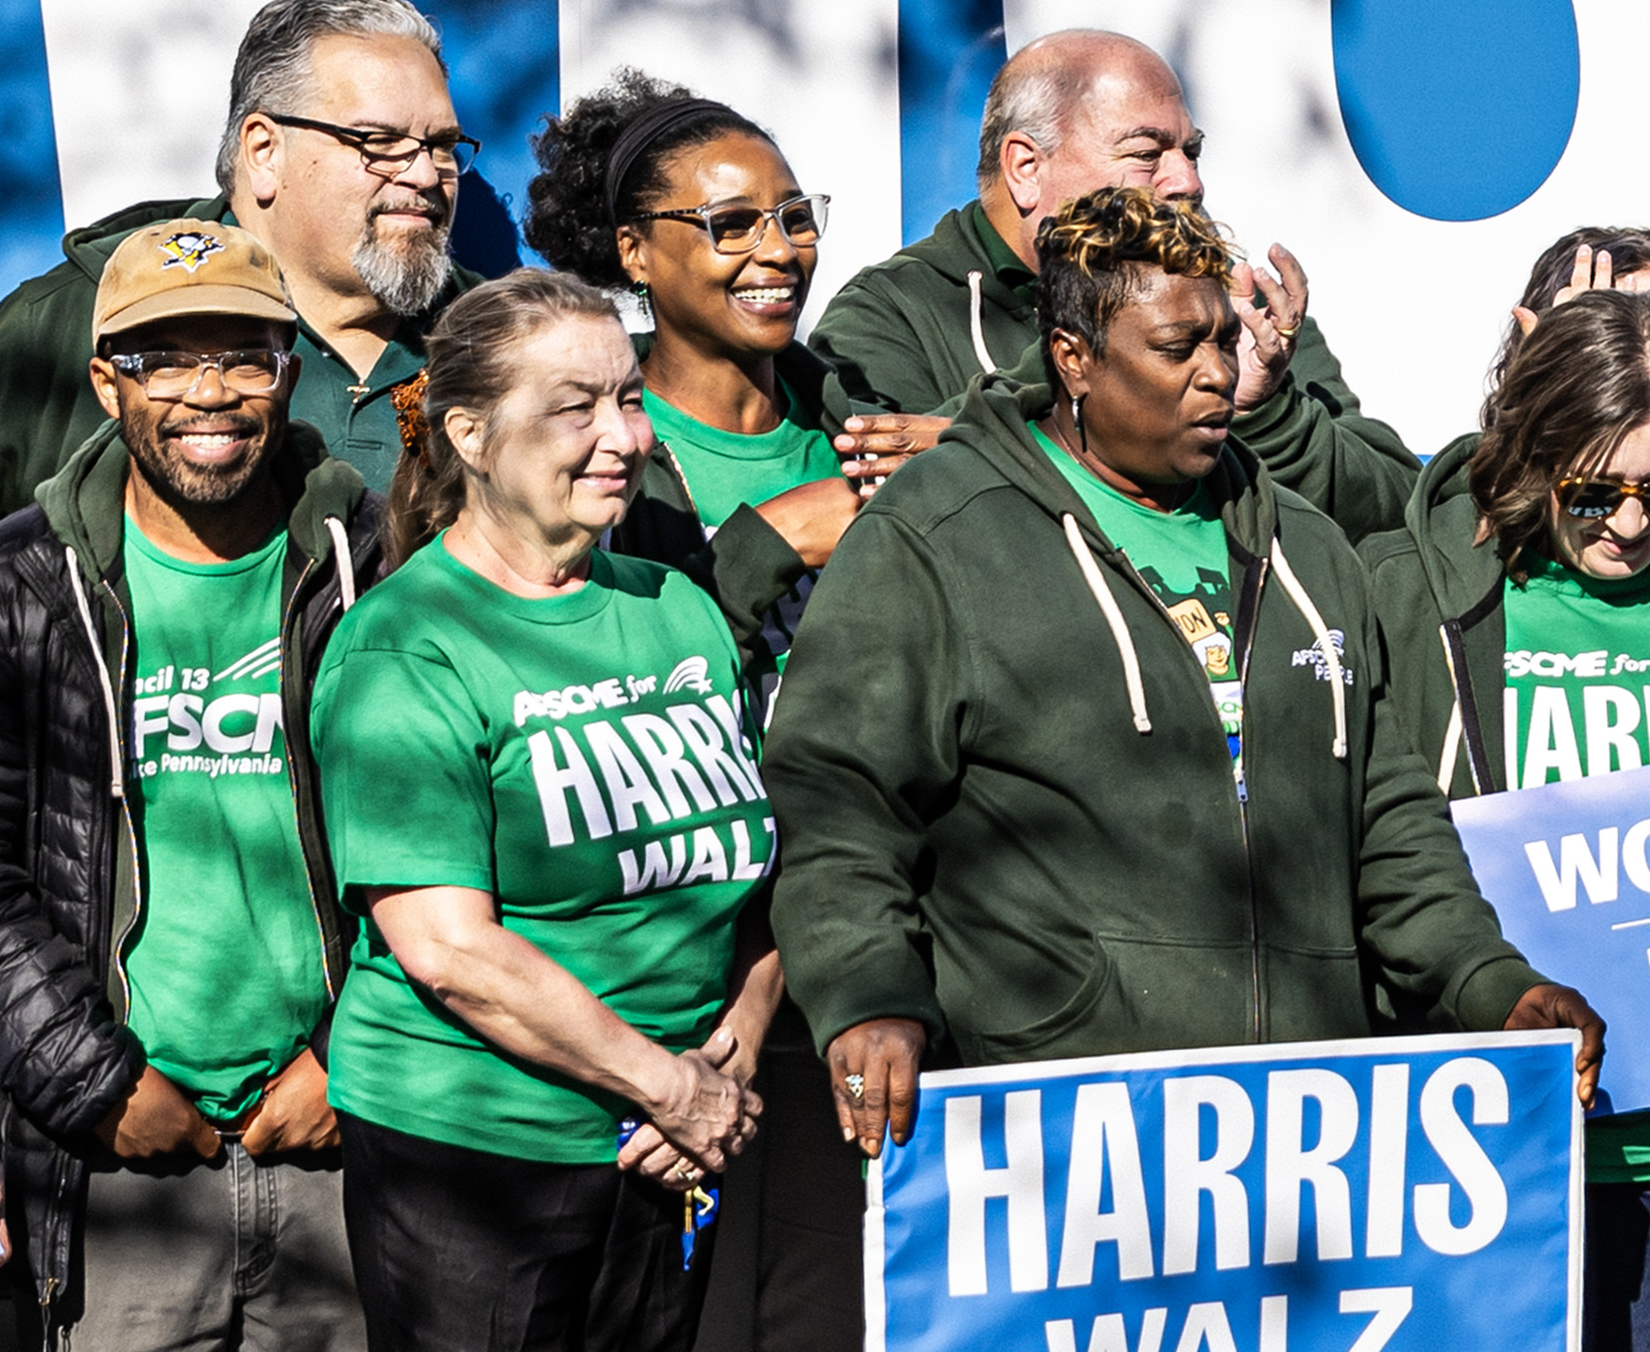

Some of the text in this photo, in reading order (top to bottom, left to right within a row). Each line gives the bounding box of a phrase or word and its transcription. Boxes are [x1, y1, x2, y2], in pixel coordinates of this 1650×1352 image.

[181, 667, 211, 691] 13
[625, 665, 658, 703] for
[161, 752, 284, 779] Pennsylvania
[944, 1055, 1511, 1298] HARRIS
